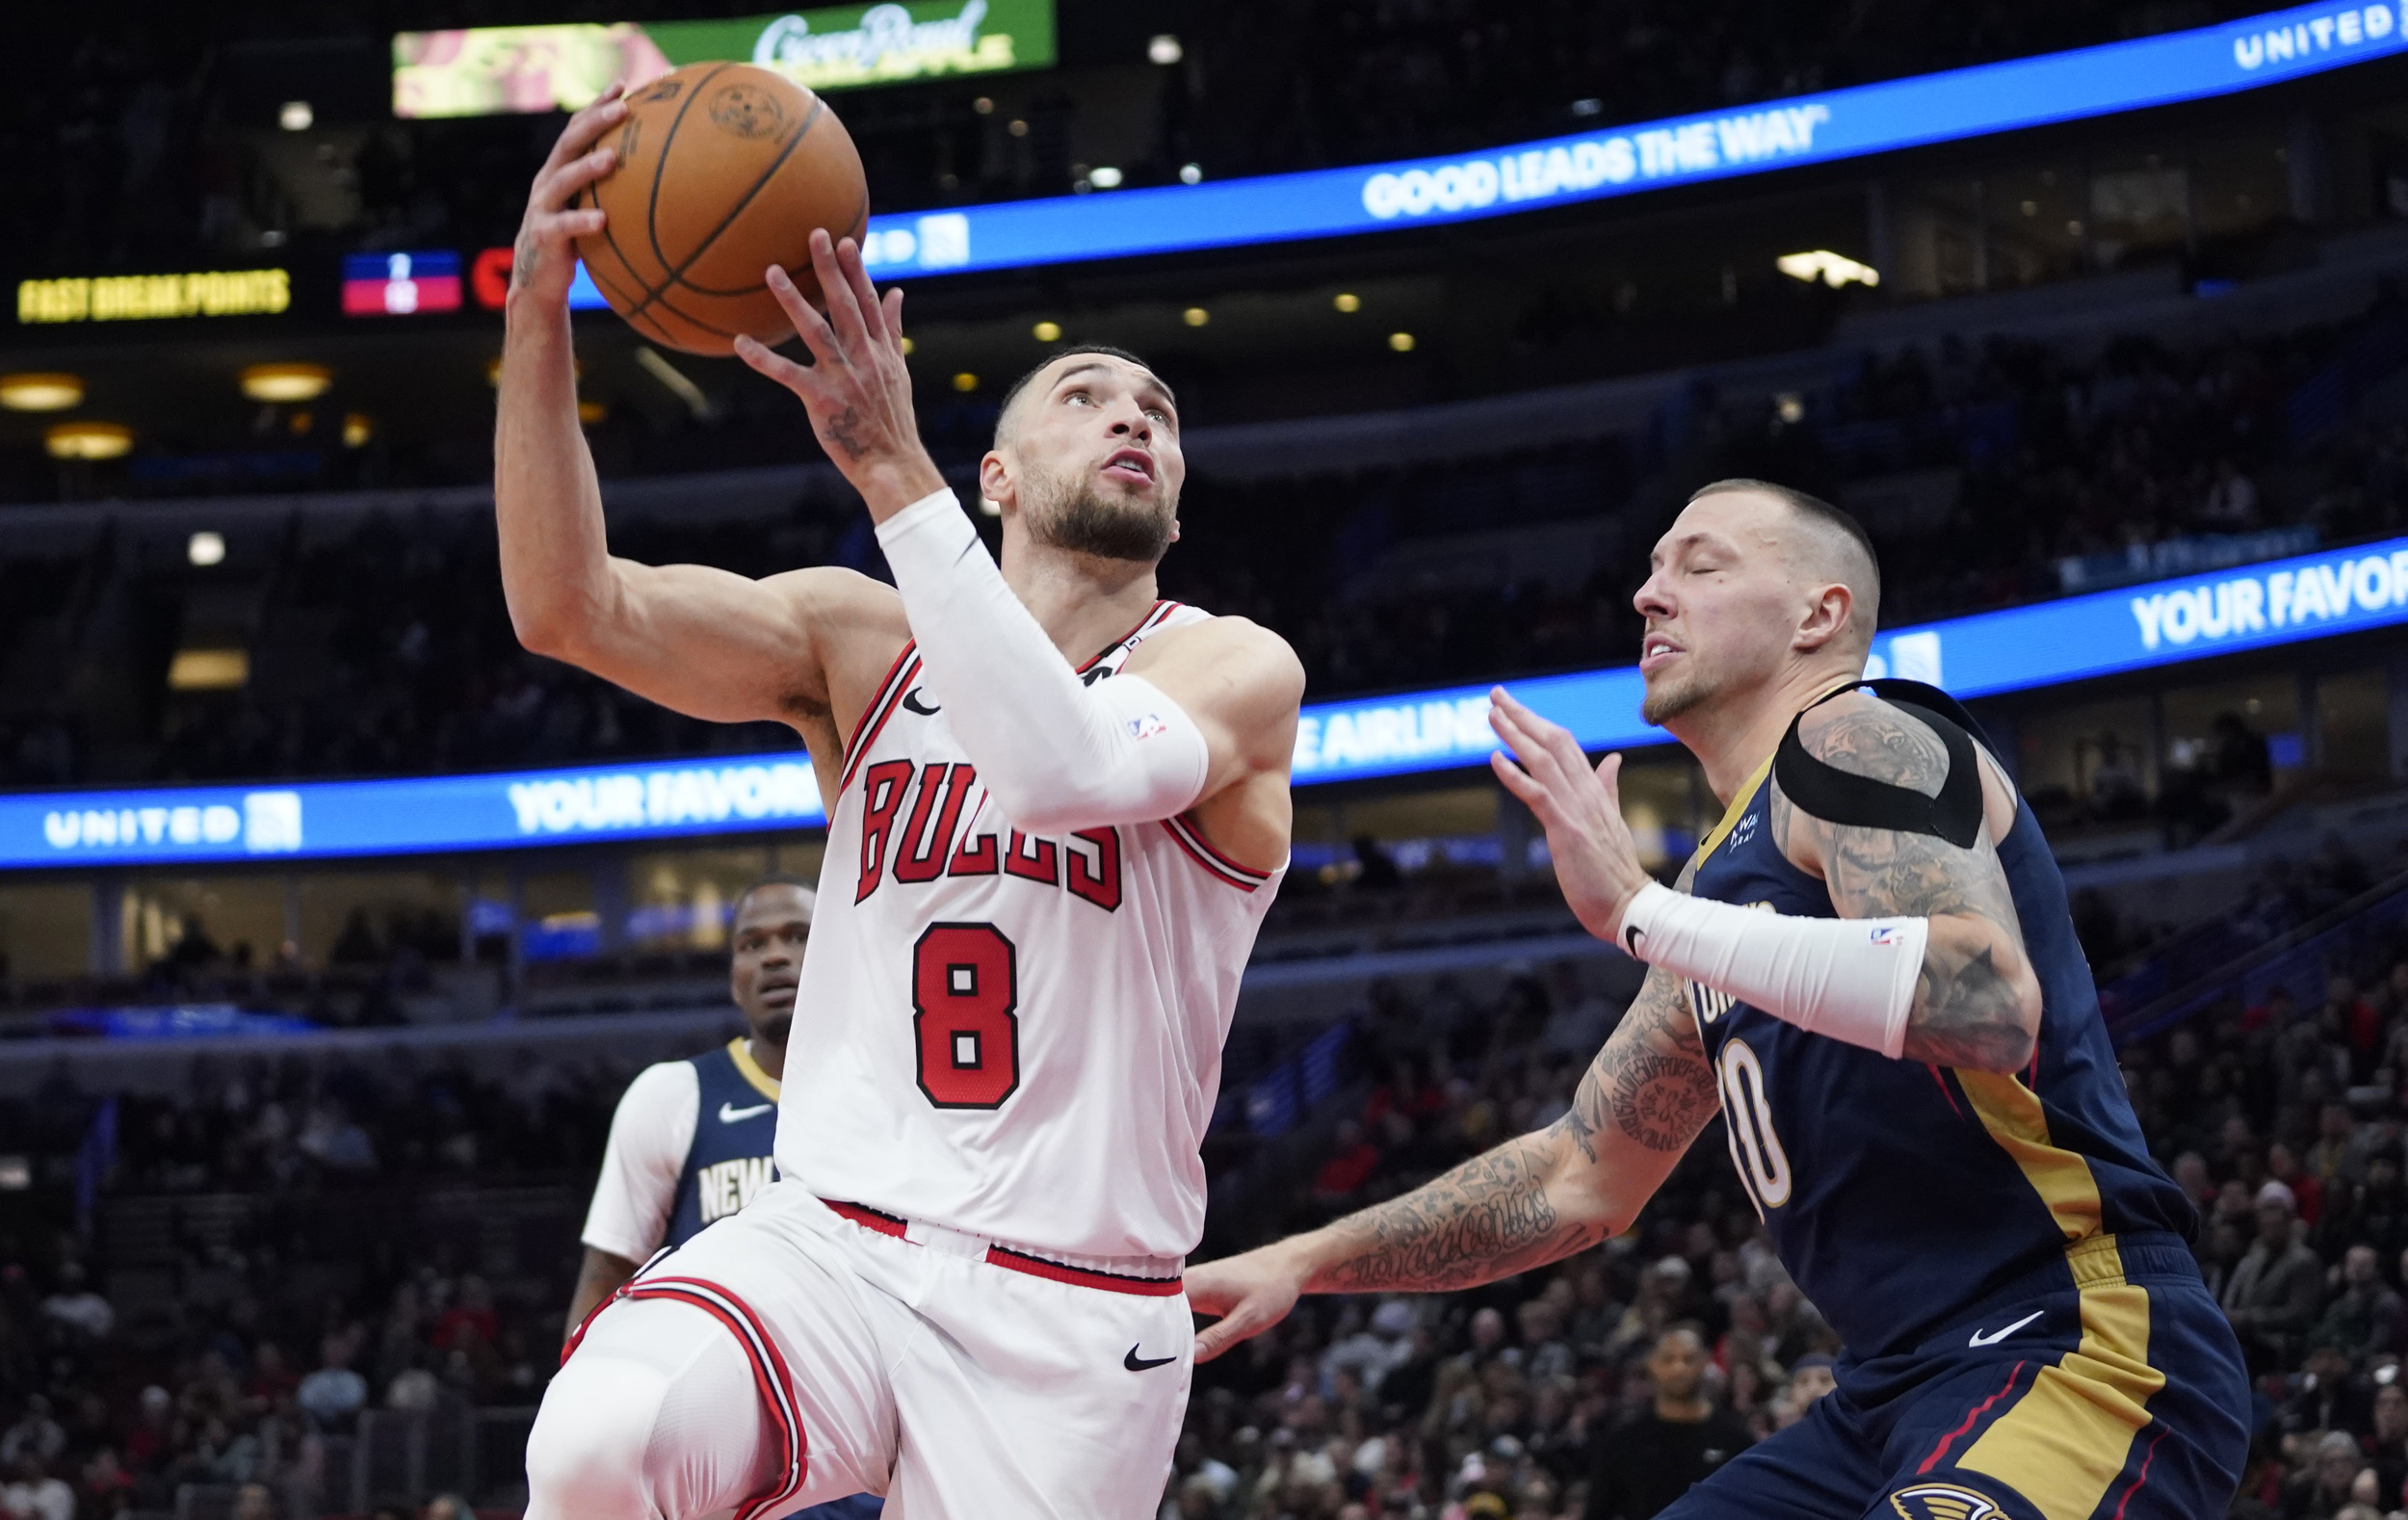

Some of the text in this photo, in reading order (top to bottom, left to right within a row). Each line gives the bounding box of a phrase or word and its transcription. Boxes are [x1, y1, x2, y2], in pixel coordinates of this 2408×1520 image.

[2234, 4, 2394, 70] UNITED
[1362, 160, 1500, 220] GOOD
[1499, 137, 1636, 201] LEADS
[1635, 122, 1718, 177] THE
[17, 268, 291, 324] FAST BREAK POINTS
[2130, 578, 2266, 650] YOUR
[44, 805, 241, 850] UNITED
[508, 773, 646, 834] YOUR
[854, 759, 1122, 913] BULLS
[913, 922, 1019, 1110] 8
[698, 1155, 774, 1224] NEW
